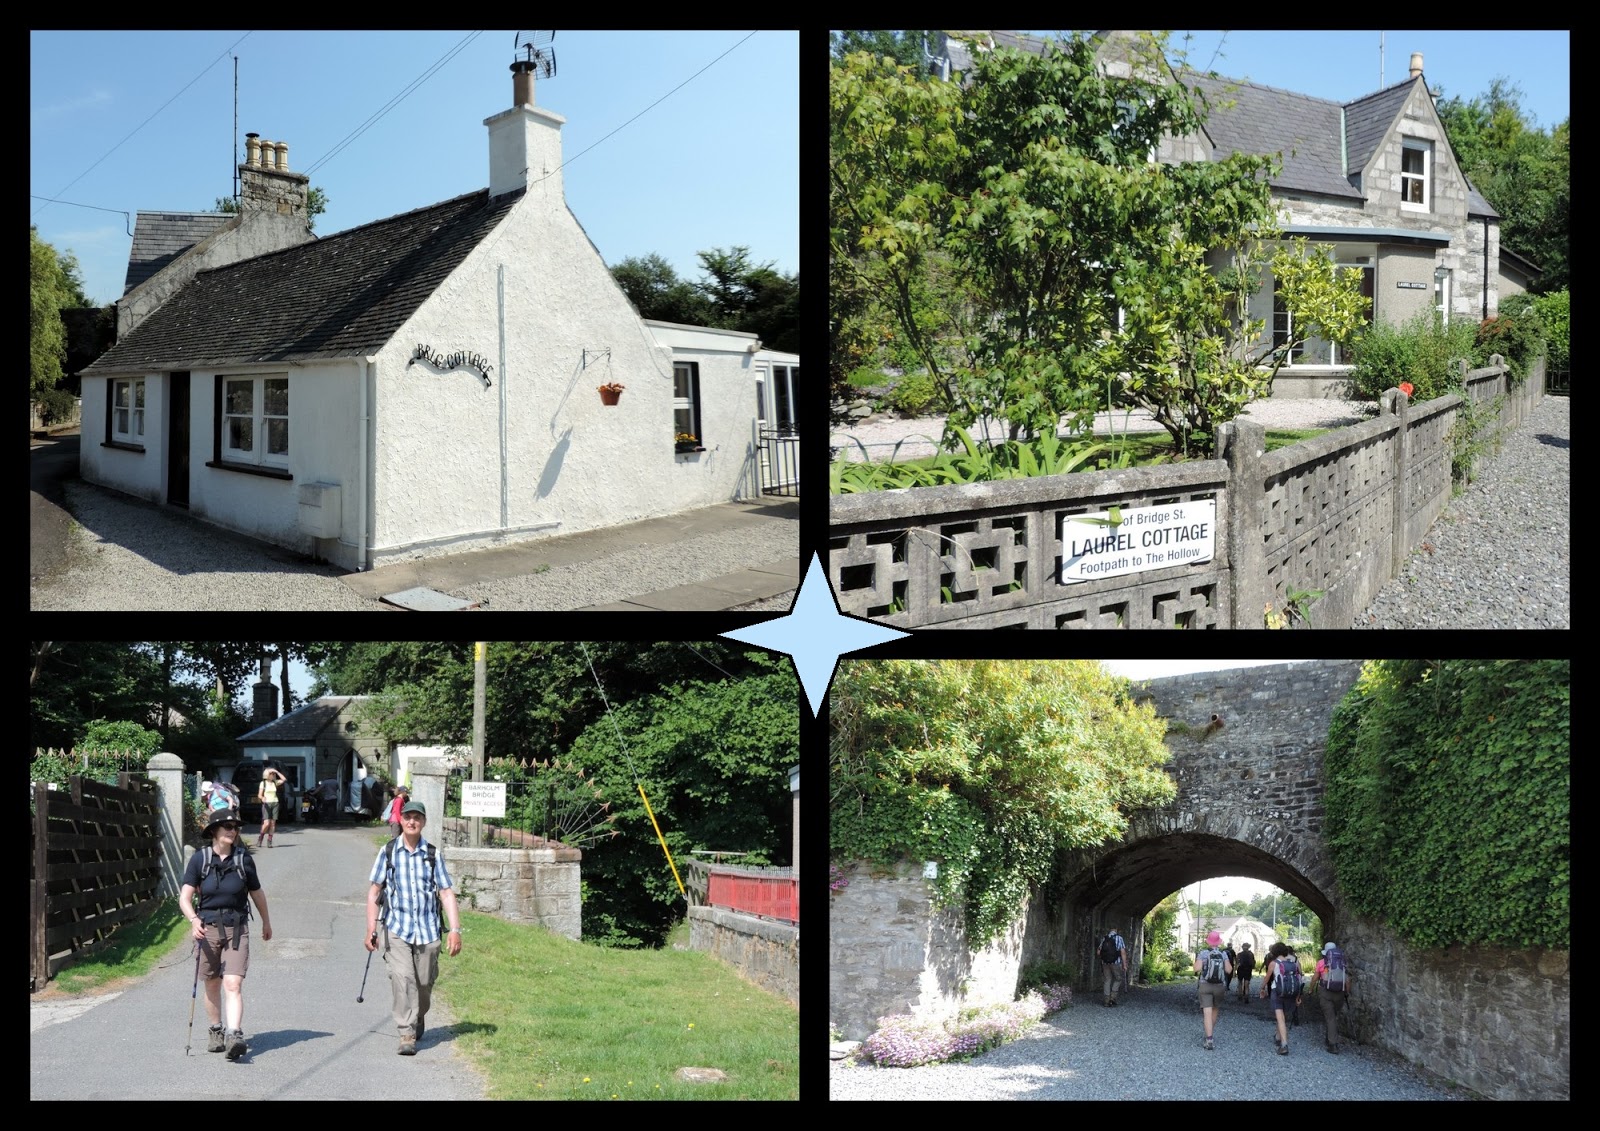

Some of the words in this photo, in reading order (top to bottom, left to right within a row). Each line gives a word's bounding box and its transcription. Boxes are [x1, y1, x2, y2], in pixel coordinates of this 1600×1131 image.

[417, 343, 443, 367] BRIG
[447, 350, 494, 374] COTTAGE
[1123, 514, 1133, 526] of
[1137, 512, 1170, 525] Bridge
[1173, 509, 1186, 520] St.
[1072, 533, 1136, 558] LAUREL
[1142, 523, 1208, 547] COTTAGE
[1080, 557, 1128, 574] Footpath
[1132, 555, 1142, 566] to
[1145, 551, 1164, 564] The
[1167, 548, 1200, 561] Hollow
